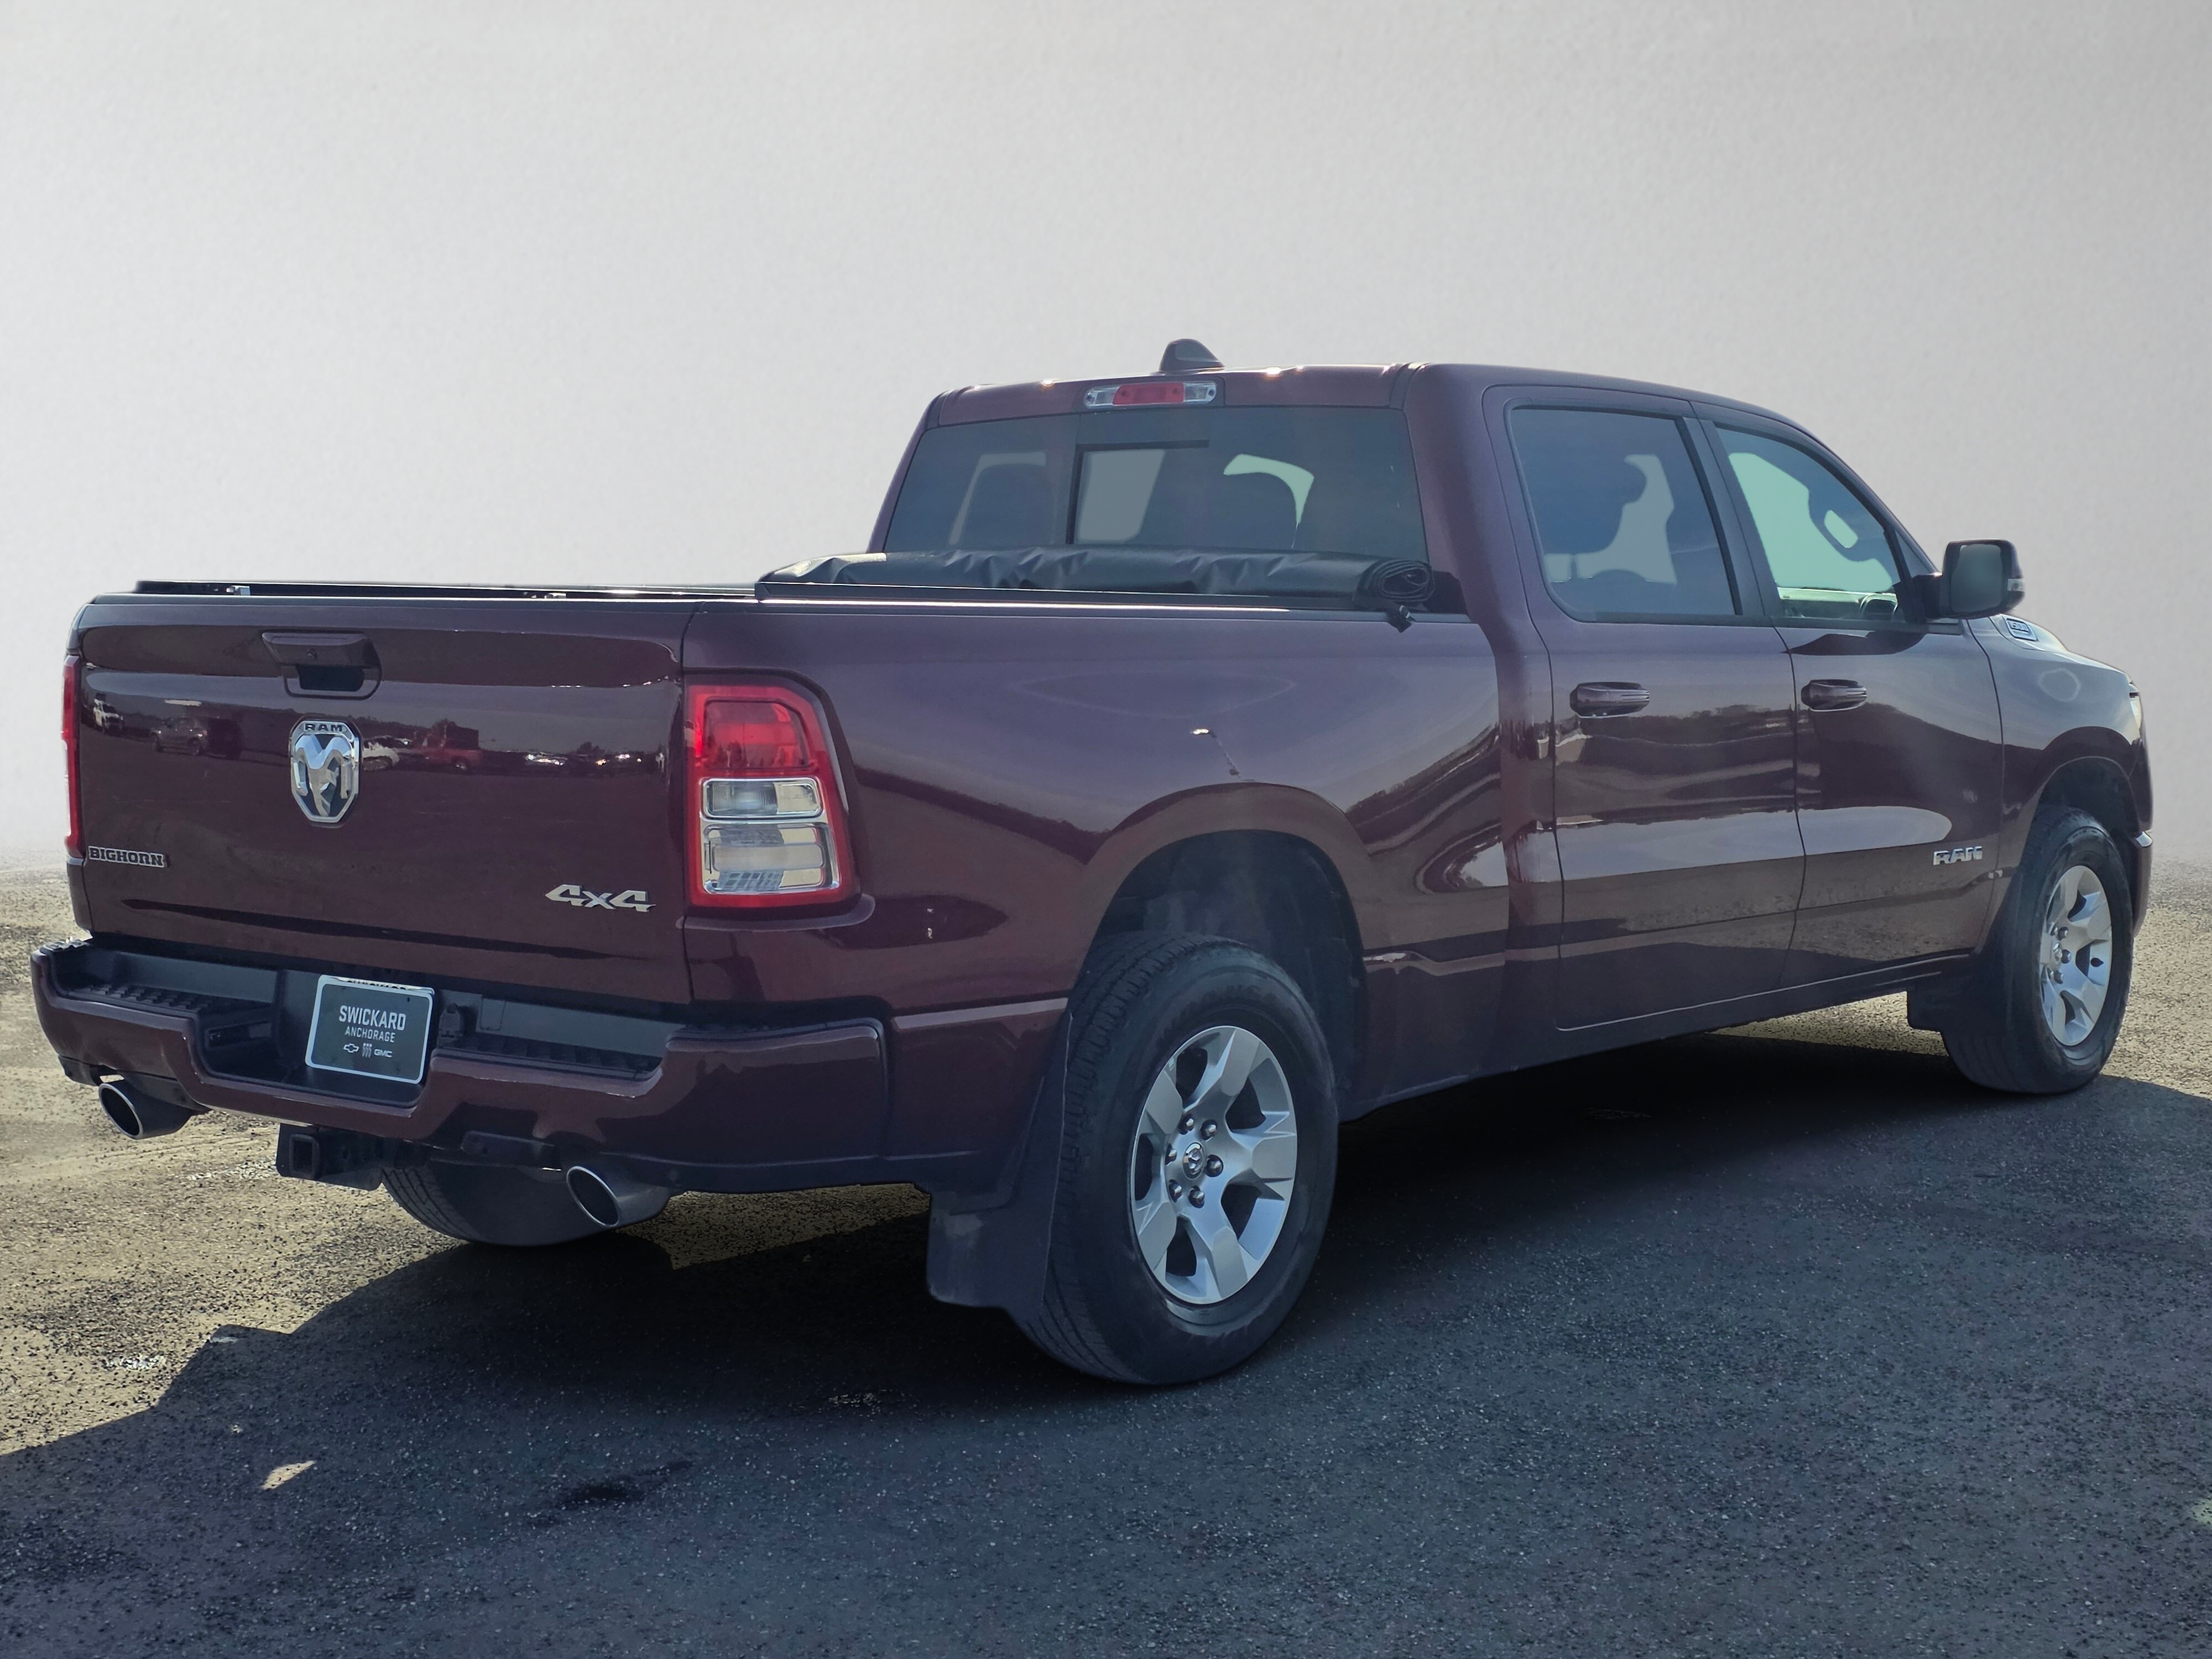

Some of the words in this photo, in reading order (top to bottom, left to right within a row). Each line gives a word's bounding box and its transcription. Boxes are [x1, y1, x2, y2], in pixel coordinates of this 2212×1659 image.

[305, 723, 342, 732] RAM
[88, 846, 164, 868] BIGHORN
[1933, 846, 1983, 865] RAM
[545, 884, 656, 912] 4x4
[338, 1005, 406, 1031] SWICKARD
[345, 1026, 395, 1042] ANCHORAGE
[374, 1049, 393, 1057] GMC
